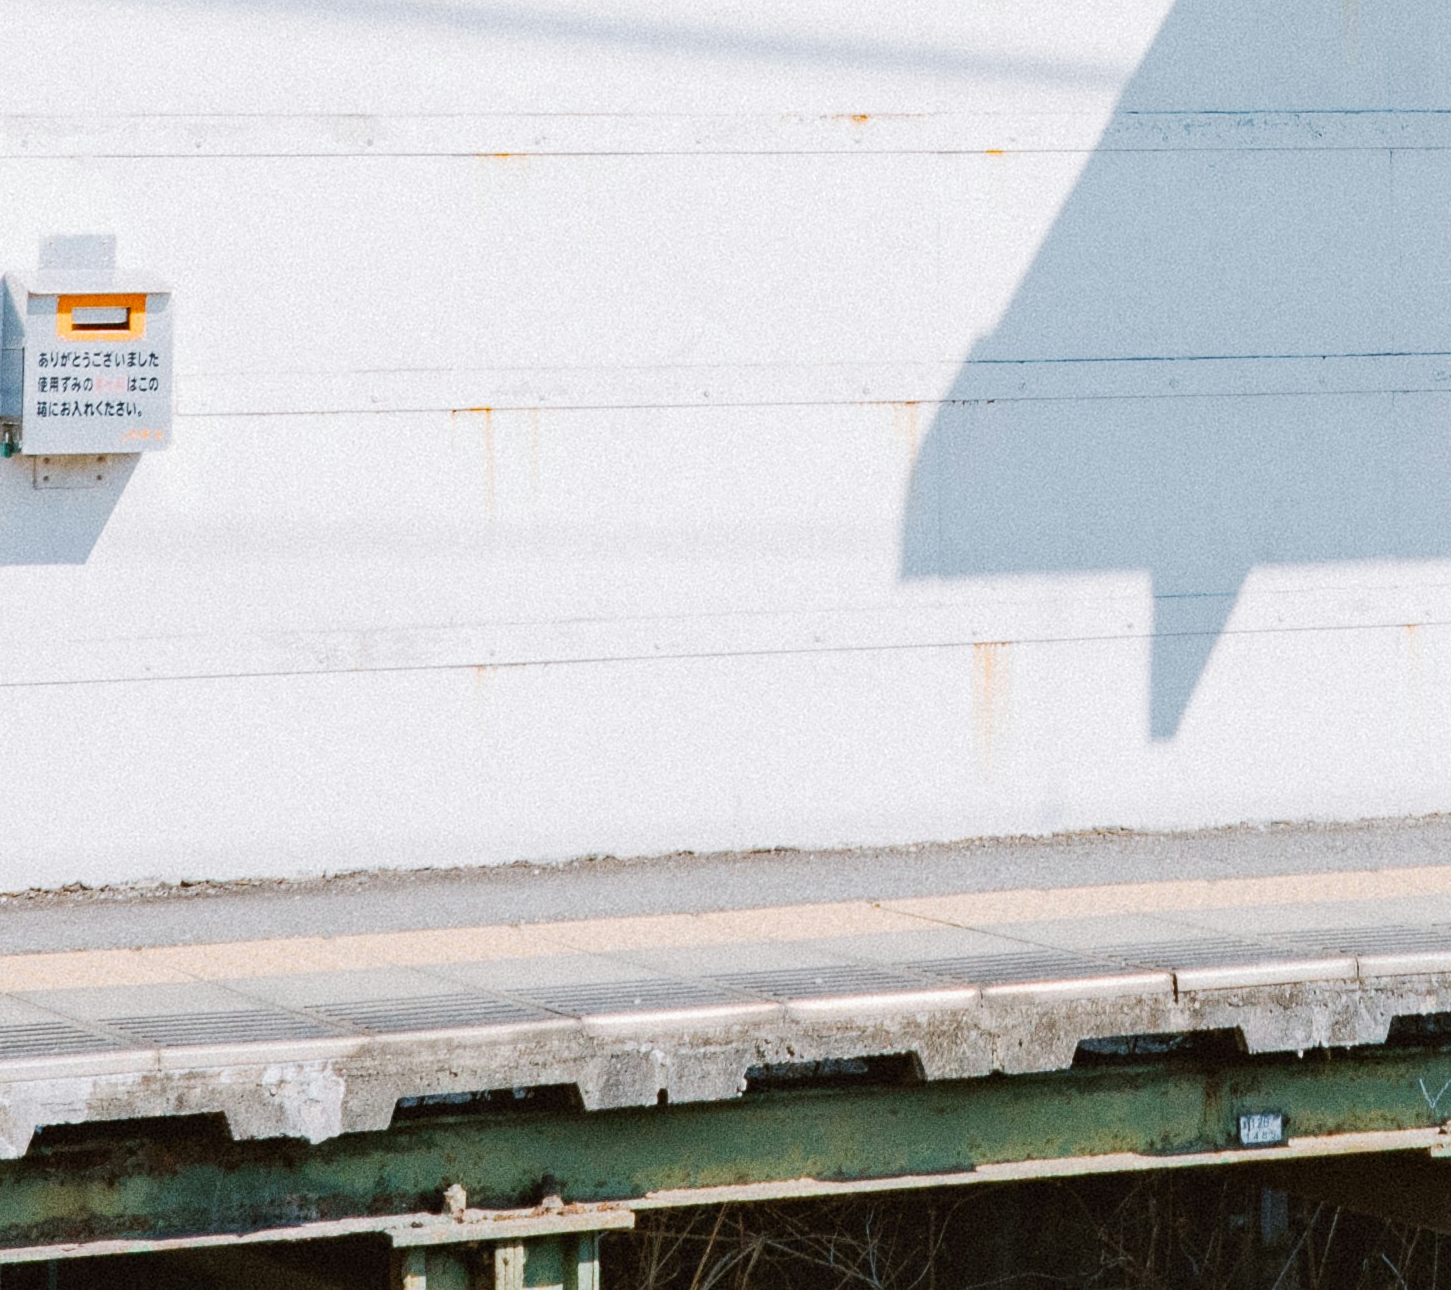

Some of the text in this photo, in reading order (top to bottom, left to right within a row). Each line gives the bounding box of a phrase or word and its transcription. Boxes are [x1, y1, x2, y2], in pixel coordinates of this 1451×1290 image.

[38, 351, 160, 368] ありがとうございました
[36, 401, 143, 418] 箱にお入れください。
